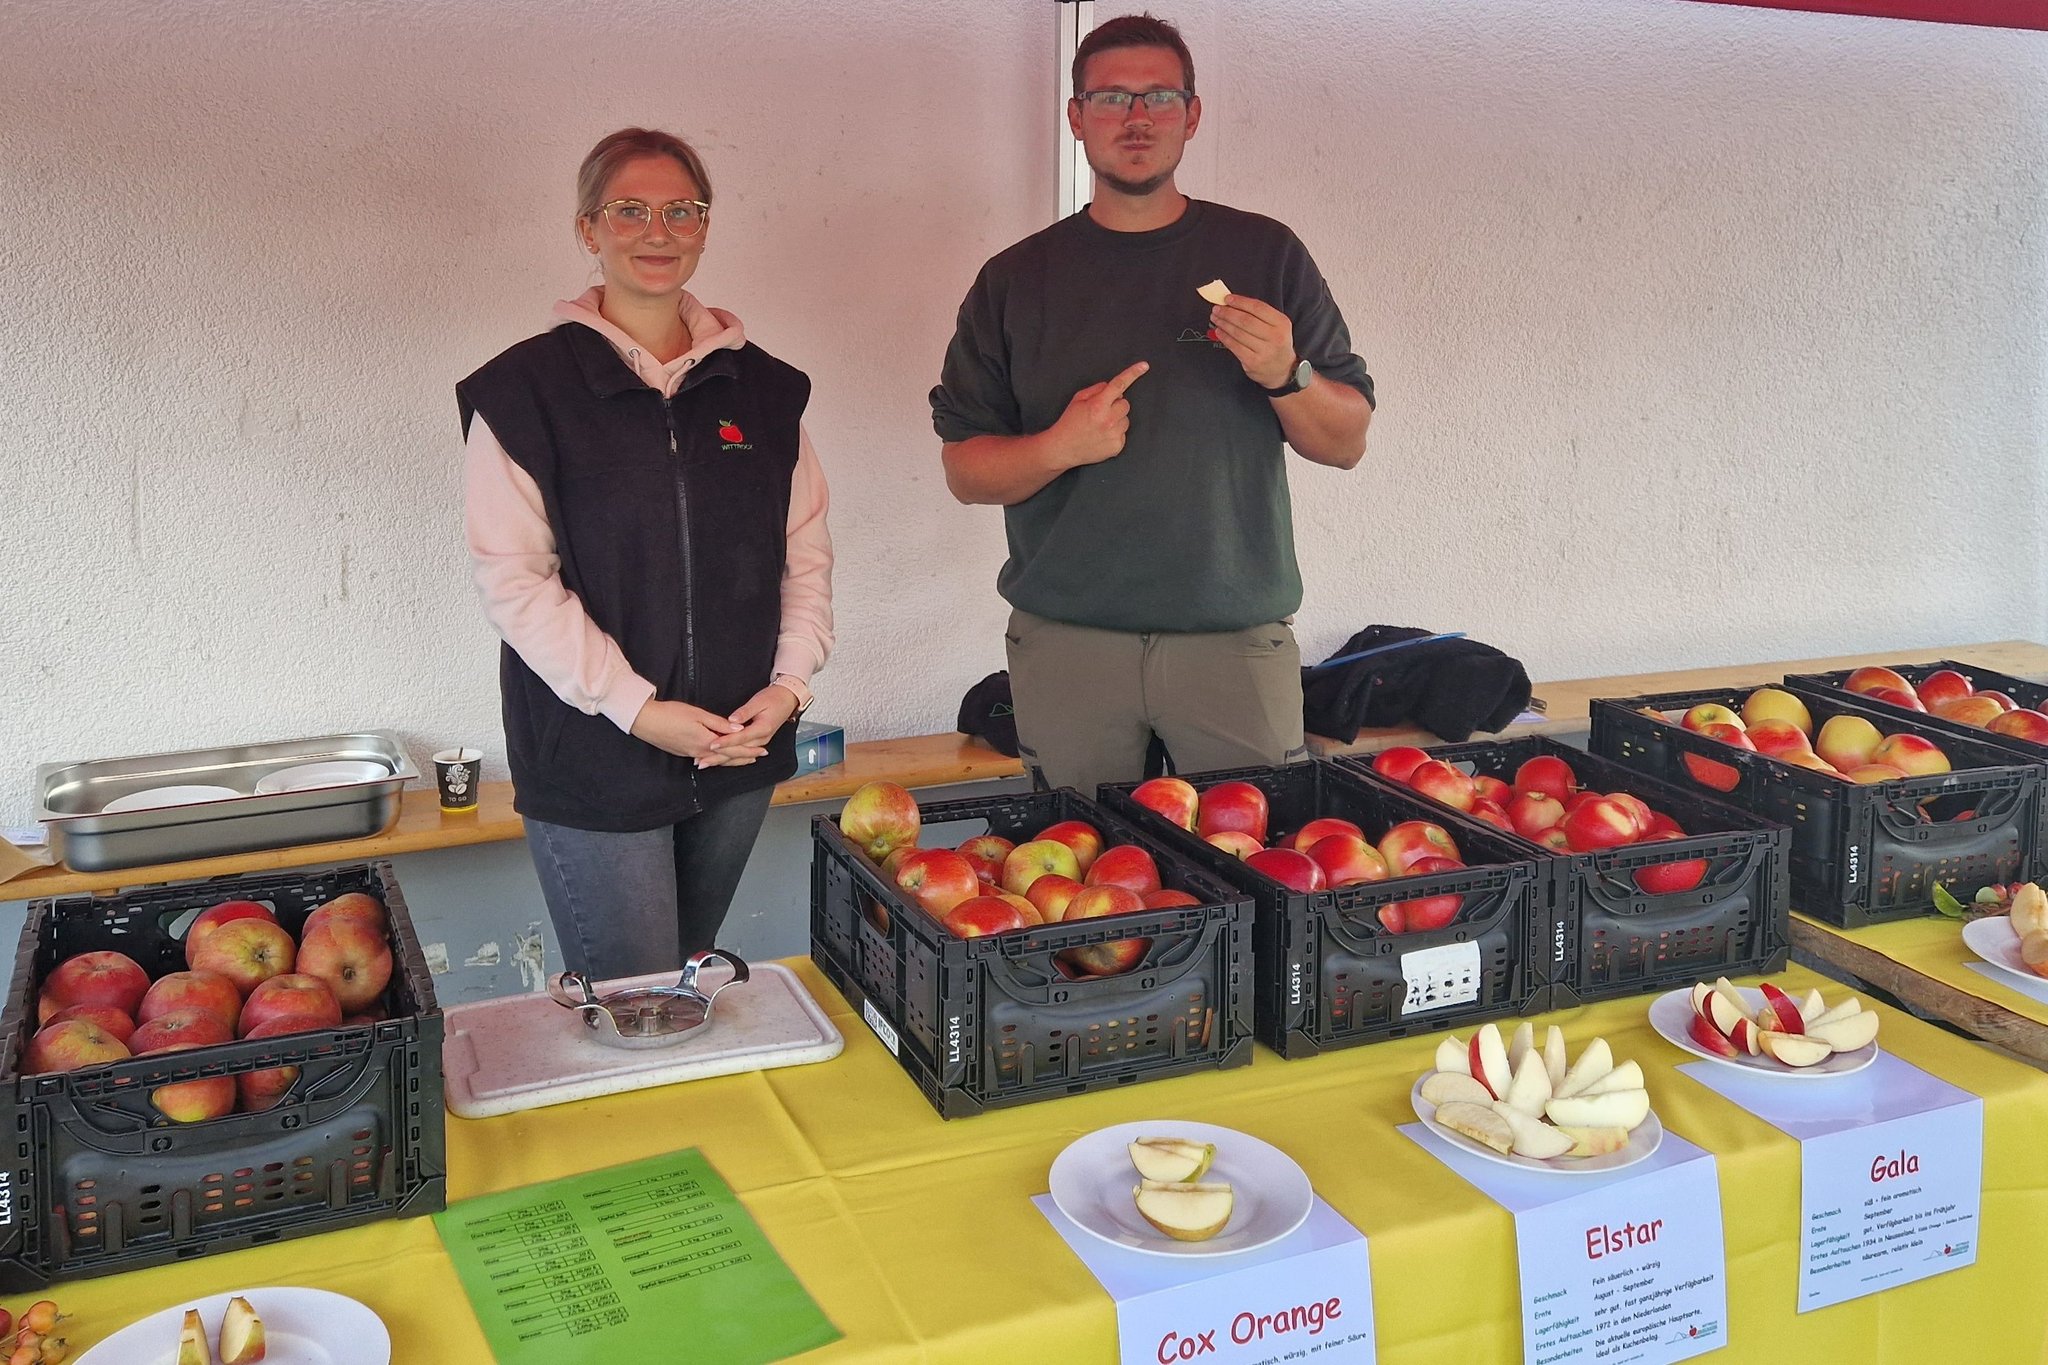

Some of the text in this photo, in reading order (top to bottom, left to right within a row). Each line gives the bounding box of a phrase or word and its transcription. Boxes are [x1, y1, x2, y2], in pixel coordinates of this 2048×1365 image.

[1849, 845, 1859, 883] LL4314
[1555, 920, 1565, 961] LL4314
[1291, 963, 1301, 1005] LL4314
[949, 1016, 960, 1063] LL4314
[1870, 1149, 1919, 1182] Gala
[0, 1171, 11, 1225] LL4314
[1812, 1208, 1841, 1220] Geschmack
[1586, 1219, 1662, 1259] Elstar
[1811, 1208, 1893, 1234] Ernte September
[1811, 1232, 1850, 1248] Lagerfähigkeit
[1877, 1215, 1913, 1229] Verfügbarkeit
[1914, 1212, 1923, 1220] bis
[1933, 1203, 1956, 1214] Frühjahr
[1810, 1253, 1828, 1261] Erstes
[1862, 1237, 1876, 1247] 1934
[1891, 1244, 1909, 1252] relativ
[1533, 1288, 1567, 1304] Geschmack
[1592, 1278, 1605, 1287] Fein
[1607, 1267, 1634, 1281] säuerlich
[1642, 1260, 1661, 1271] würzig
[1534, 1310, 1552, 1320] Ernte
[1594, 1289, 1614, 1301] August
[1623, 1278, 1655, 1292] September
[1535, 1316, 1579, 1335] Lagerfähigkeit
[1594, 1308, 1607, 1317] sehr
[1624, 1298, 1637, 1307] fast
[1639, 1288, 1672, 1304] ganzjährige
[1674, 1274, 1714, 1291] Verfügbarkeit
[1157, 1297, 1342, 1365] Cox Orange
[1311, 1344, 1321, 1353] mit
[1325, 1338, 1345, 1350] feiner
[1347, 1332, 1366, 1344] Säure
[1535, 1340, 1556, 1351] Erstes
[1559, 1328, 1593, 1343] Auftauchen
[1596, 1320, 1611, 1331] 1972
[1621, 1315, 1631, 1324] den
[1633, 1303, 1672, 1319] Niederlanden
[1536, 1347, 1584, 1365] Besonderheiten
[1595, 1339, 1605, 1347] Die
[1607, 1330, 1631, 1343] aktuelle
[1633, 1319, 1667, 1335] europäische
[1611, 1344, 1621, 1353] als
